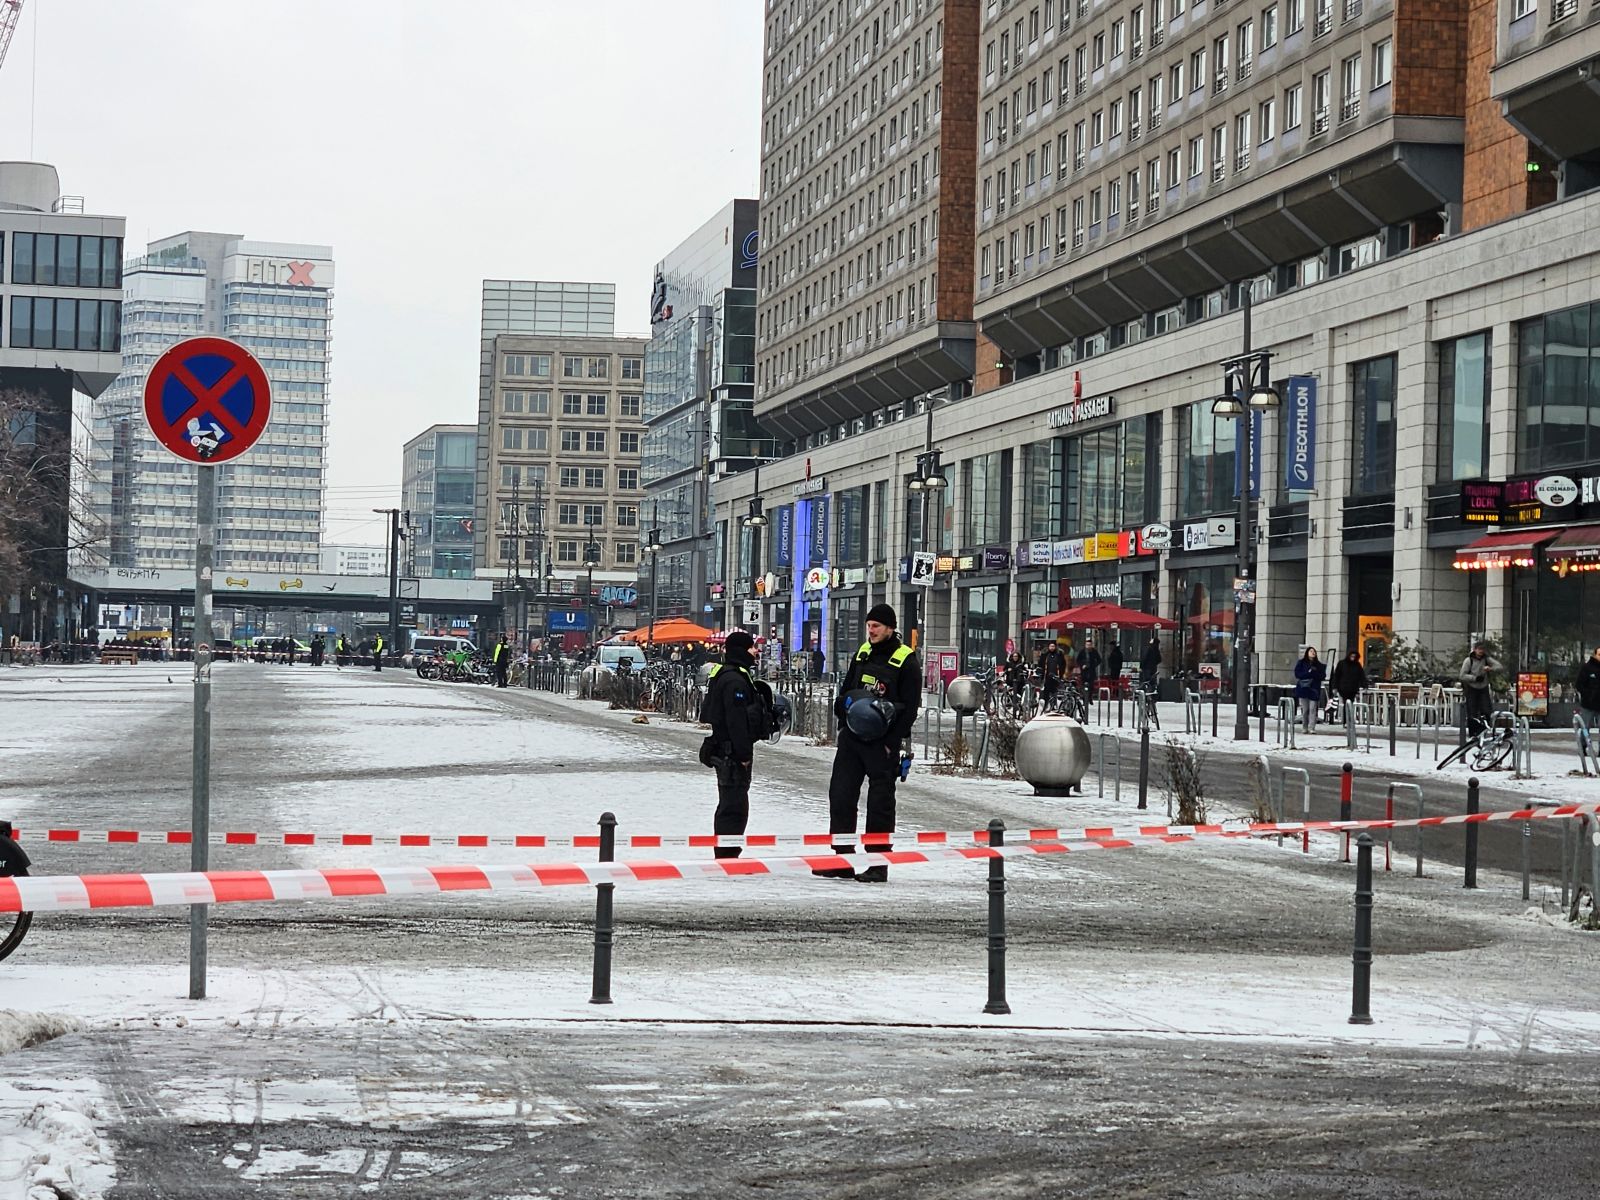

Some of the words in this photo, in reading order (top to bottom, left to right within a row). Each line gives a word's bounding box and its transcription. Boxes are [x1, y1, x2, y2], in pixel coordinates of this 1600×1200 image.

[1046, 405, 1074, 429] RATHAUS
[1076, 396, 1110, 421] PASSAGEN
[1295, 386, 1309, 462] DECATHLON
[1466, 513, 1485, 521] INDIAN
[1485, 513, 1499, 522] FOOD
[1471, 497, 1496, 508] LOCAL
[781, 509, 790, 551] DECATHLON
[817, 501, 825, 545] DECATHLON
[566, 612, 576, 623] U
